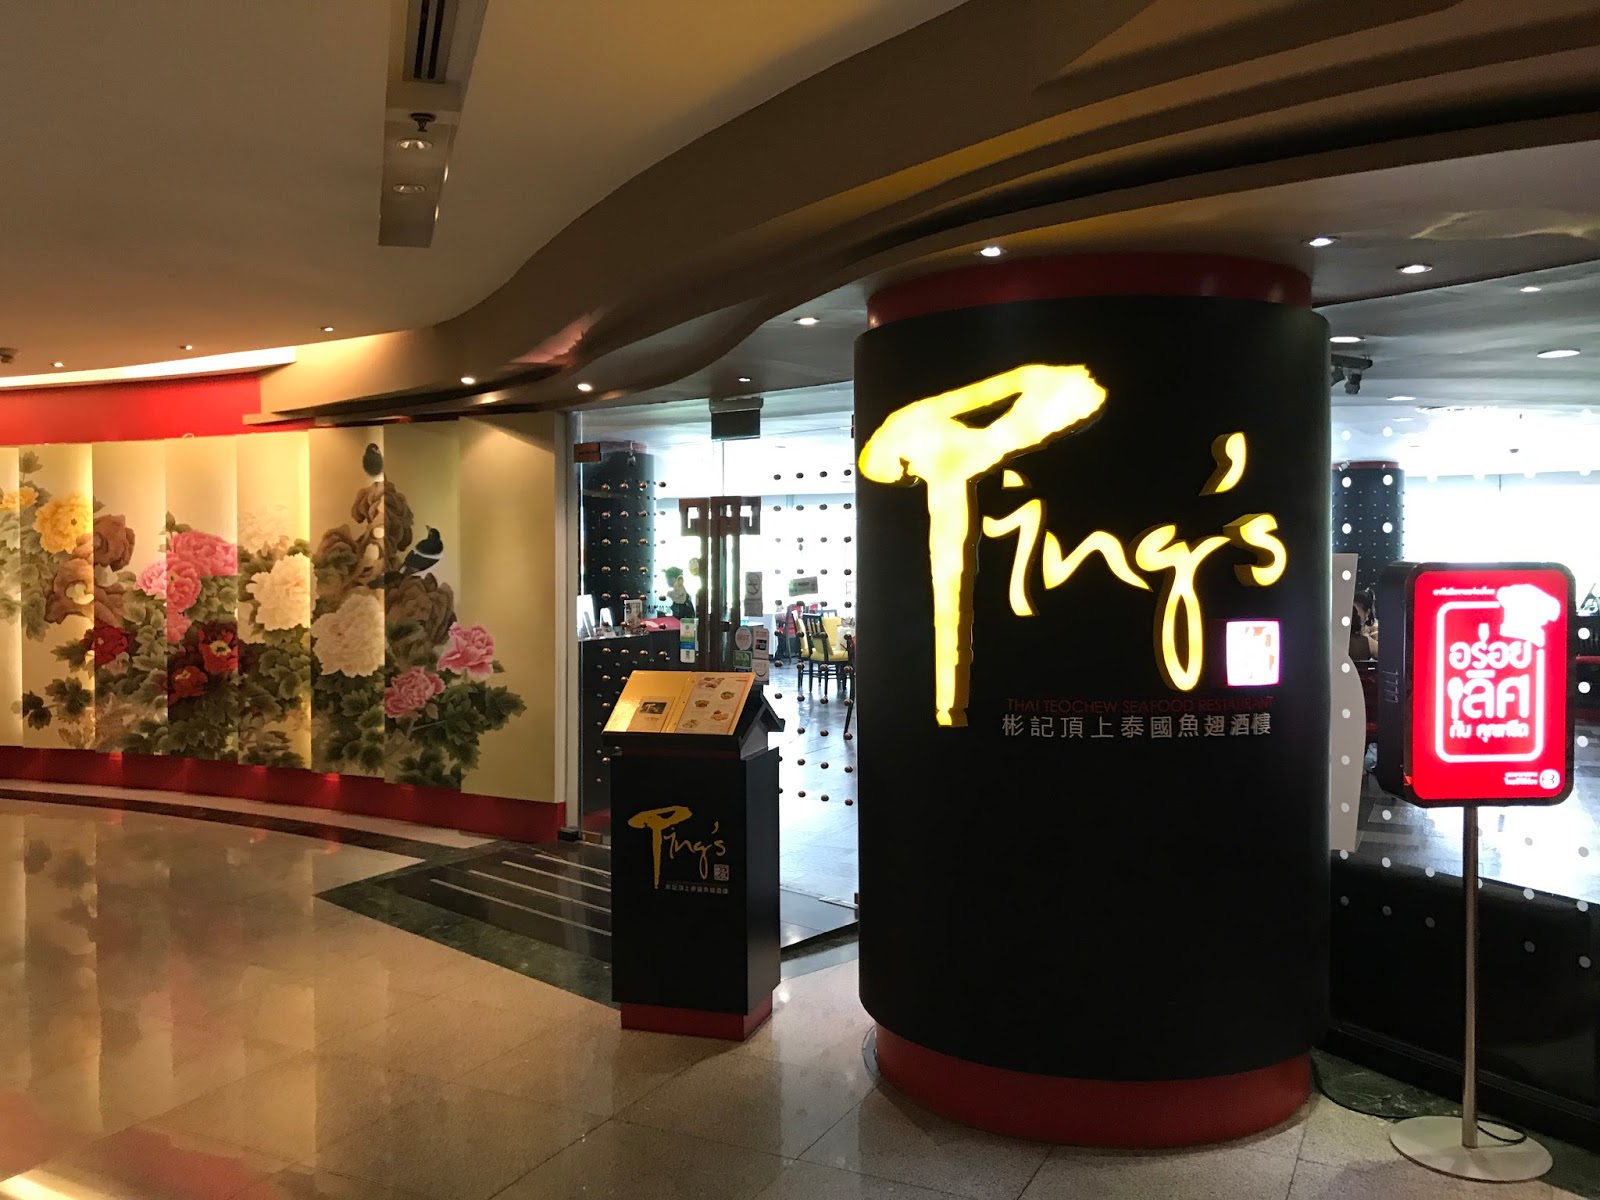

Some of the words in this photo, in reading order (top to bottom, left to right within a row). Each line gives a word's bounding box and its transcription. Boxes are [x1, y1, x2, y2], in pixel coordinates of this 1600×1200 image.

[858, 363, 1287, 727] Ting's
[1449, 623, 1532, 669] อร่อย
[1001, 712, 1271, 739] 彬記頂上泰國魚翅酒樓
[1006, 698, 1040, 711] THAI
[1043, 699, 1117, 713] TEOCHEW
[1122, 699, 1194, 713] SEAFOOD
[627, 805, 726, 889] Ting's
